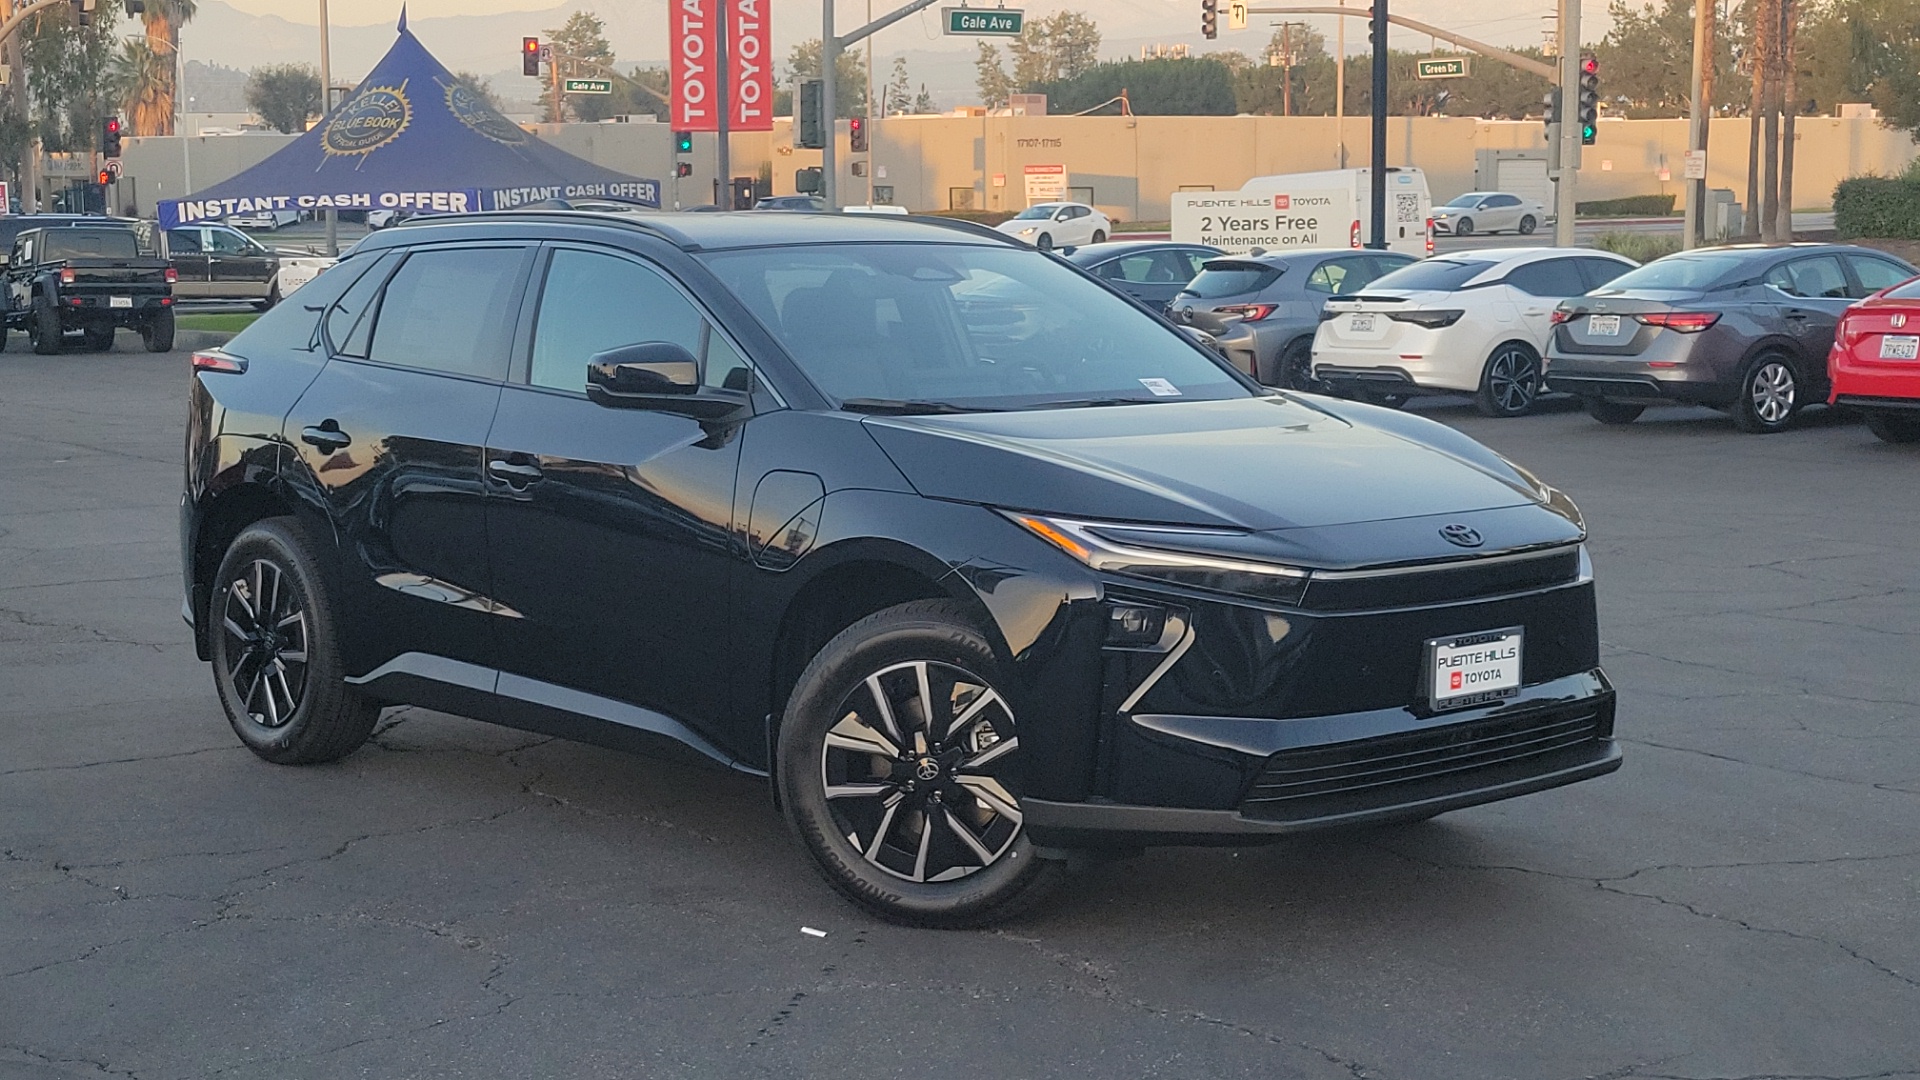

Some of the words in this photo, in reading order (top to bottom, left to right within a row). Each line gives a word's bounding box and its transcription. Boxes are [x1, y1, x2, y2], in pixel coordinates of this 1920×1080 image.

[961, 15, 987, 29] Gale
[989, 16, 1013, 29] Ave
[682, 0, 705, 123] TOYOTA
[738, 0, 760, 123] TOYOTA
[1425, 64, 1447, 74] Green
[1447, 63, 1457, 73] Dr
[571, 82, 589, 90] Gale
[589, 82, 605, 91] Ave
[348, 94, 402, 115] KELLEY
[332, 117, 364, 131] BLUE
[363, 117, 401, 128] BOOK
[493, 186, 561, 211] INSTANT
[565, 184, 606, 197] CASH
[609, 183, 655, 201] OFFER
[1187, 200, 1236, 208] PUENTE
[1240, 199, 1272, 207] HILLS
[1292, 197, 1331, 206] TOYOTA
[178, 196, 290, 223] INSTANT
[297, 193, 371, 208] CASH
[379, 192, 468, 213] OFFER
[1201, 217, 1212, 232] 2
[1218, 216, 1269, 232] Years
[1275, 215, 1318, 231] Free
[1201, 235, 1279, 246] Maintenance
[1282, 234, 1298, 245] on
[1301, 233, 1318, 244] All
[1438, 652, 1483, 669] PUENTE
[1484, 647, 1516, 662] HILLS
[1464, 668, 1502, 684] TOYOTA
